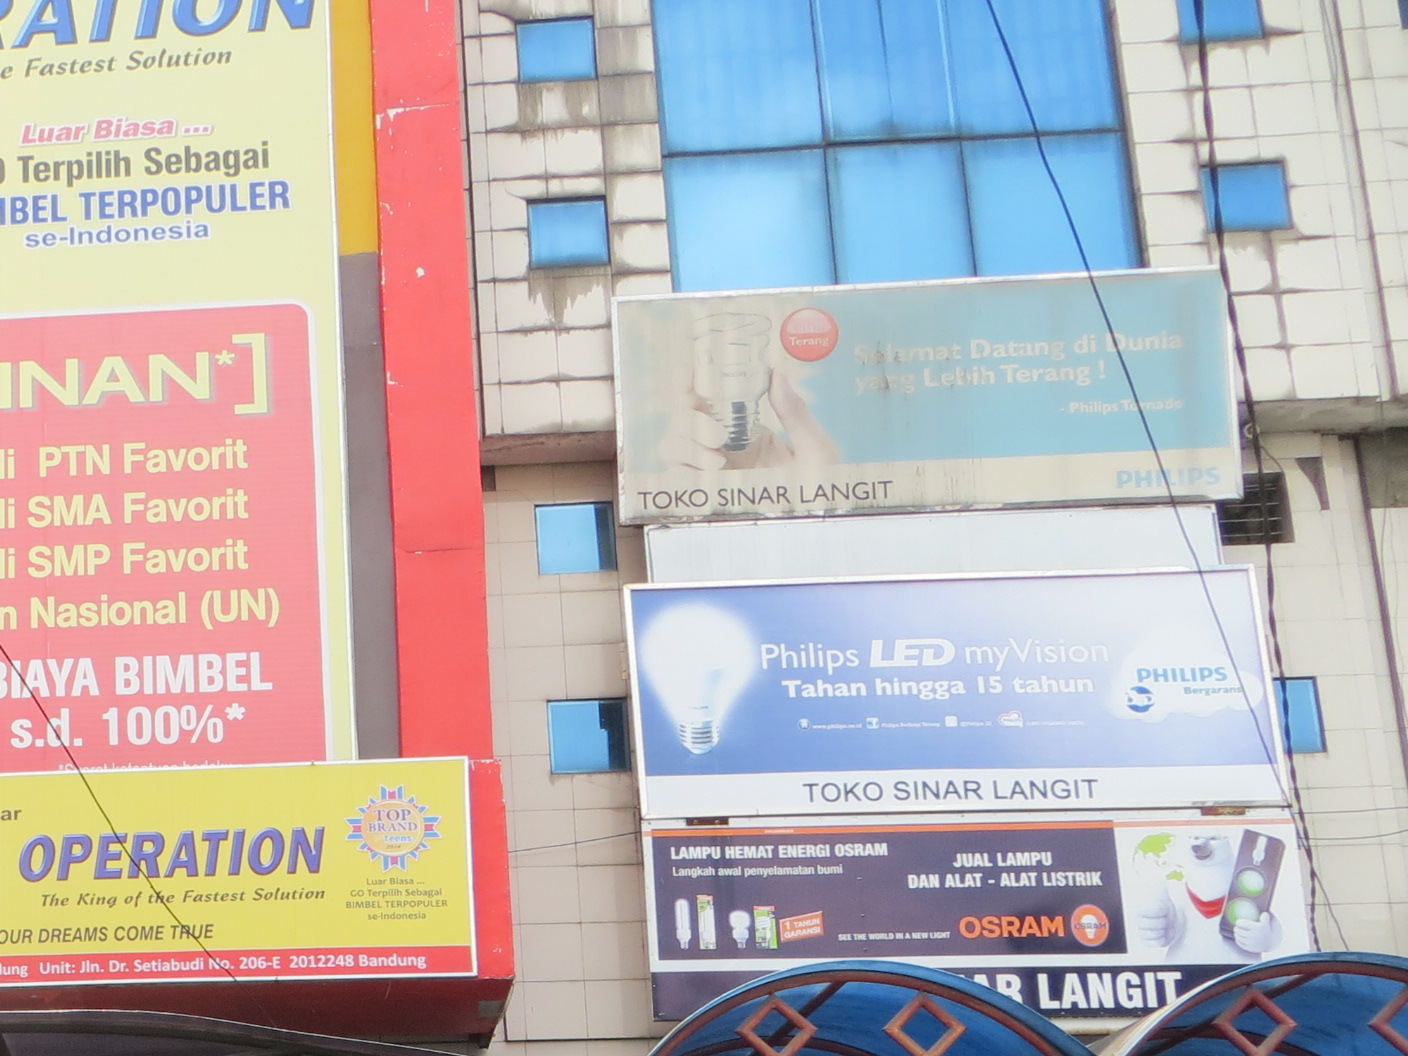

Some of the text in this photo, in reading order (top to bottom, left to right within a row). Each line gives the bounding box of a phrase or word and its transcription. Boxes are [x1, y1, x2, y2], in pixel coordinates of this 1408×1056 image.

[25, 55, 117, 78] Fastest
[126, 48, 232, 72] Solution
[17, 151, 131, 187] Terpilih
[144, 141, 269, 178] Sebagai
[79, 181, 290, 221] TERPOPULER
[25, 221, 209, 248] se-Indonesia
[38, 443, 111, 477] PTN
[122, 438, 248, 474] Favorit
[1116, 467, 1220, 488] PHILIPS
[27, 494, 111, 528] SMA
[122, 489, 248, 524] Favorit
[638, 480, 893, 509] TOKO SINAR LANGIT
[27, 543, 111, 577] SMP
[122, 539, 248, 574] Favorit
[30, 592, 186, 629] Nasional
[201, 588, 280, 630] (UN)
[761, 637, 1110, 675] Philips LED myVision
[115, 651, 272, 694] BIMBEL
[1136, 666, 1228, 683] PHILIPS
[781, 675, 1094, 700] Tahan hingga 15 tahun
[10, 708, 83, 748] s.d.
[803, 779, 1098, 802] TOKO SINAR LANGIT
[19, 826, 325, 882] OPERATION
[670, 843, 888, 859] LAMPU HEMAT ENERGI OSRAM
[953, 852, 1052, 868] JUAL LAMPU
[672, 864, 843, 878] Langkah awal penyelamatan bumi
[908, 874, 940, 889] DAN
[945, 873, 982, 888] ALAT
[1000, 872, 1038, 887] ALAT
[1042, 871, 1103, 886] LISTRIK
[38, 927, 108, 943] DREAMS
[114, 925, 164, 941] COME
[170, 924, 214, 940] TRUE
[958, 915, 1066, 939] OSRAM
[39, 961, 76, 975] Unit:
[79, 960, 104, 974] Jln.
[109, 959, 130, 973] Dr.
[134, 957, 204, 972] Setiabudi
[209, 957, 235, 970] No.
[239, 955, 281, 969] 206-E
[289, 955, 354, 969] 2012248
[359, 954, 427, 969] Bandung
[1038, 971, 1182, 1010] LANGIT
